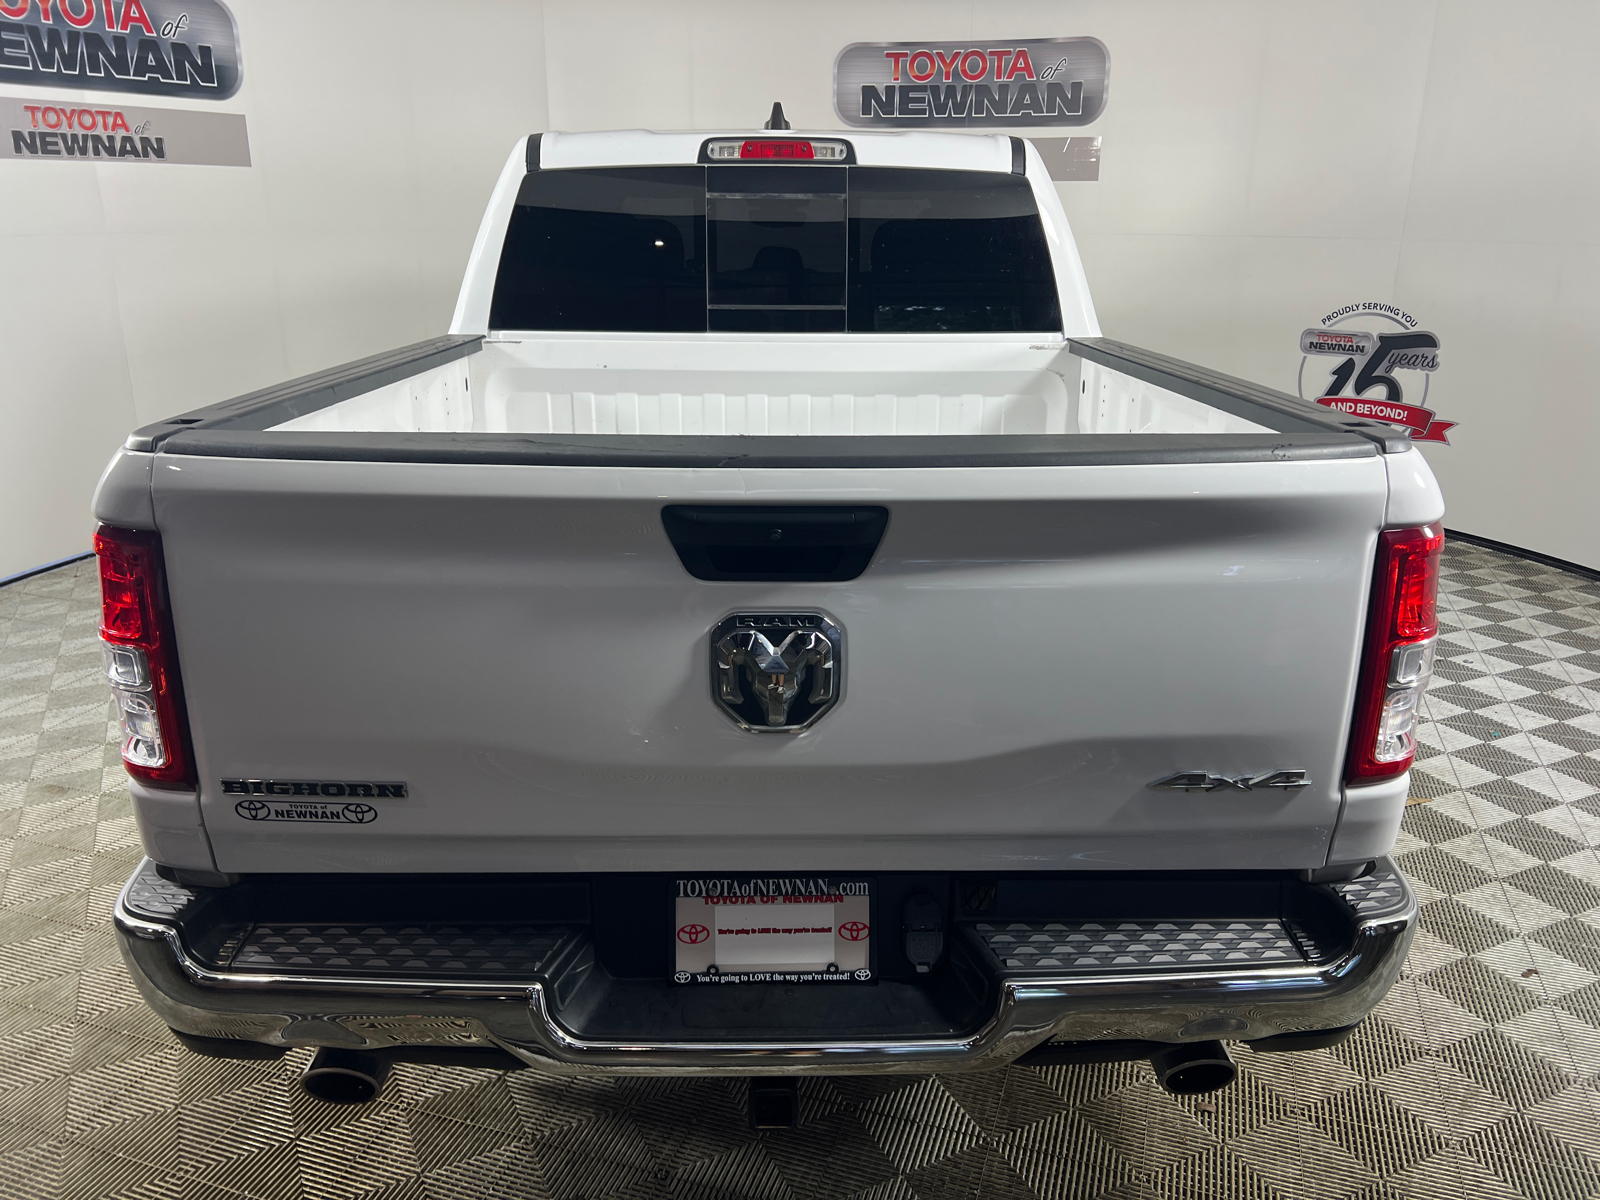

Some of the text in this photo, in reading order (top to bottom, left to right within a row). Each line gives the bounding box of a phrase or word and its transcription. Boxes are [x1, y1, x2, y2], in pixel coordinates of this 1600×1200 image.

[160, 13, 188, 38] of
[0, 20, 217, 87] EWNAN
[884, 48, 1067, 82] TOYOTA of
[860, 81, 1083, 118] NEWNAN
[24, 105, 150, 135] TOYOTA of
[11, 130, 166, 160] NEWNAN
[1321, 302, 1418, 328] PROUDLY SERVING YOU
[1309, 341, 1365, 353] NEWNAN
[1316, 334, 1354, 344] TOYOTA
[1324, 334, 1438, 402] 15 years
[1330, 402, 1407, 421] AND BEYOND!
[736, 616, 815, 627] RAM
[220, 779, 409, 798] BIGHORN
[275, 809, 341, 820] NEWNAN
[702, 894, 844, 905] TOYOTA OF NEWNAN
[697, 974, 719, 982] You're
[720, 974, 740, 983] going
[749, 973, 771, 981] LOVE
[773, 973, 784, 981] the
[785, 974, 798, 982] way
[800, 972, 821, 982] you're
[823, 972, 850, 981] treated!
